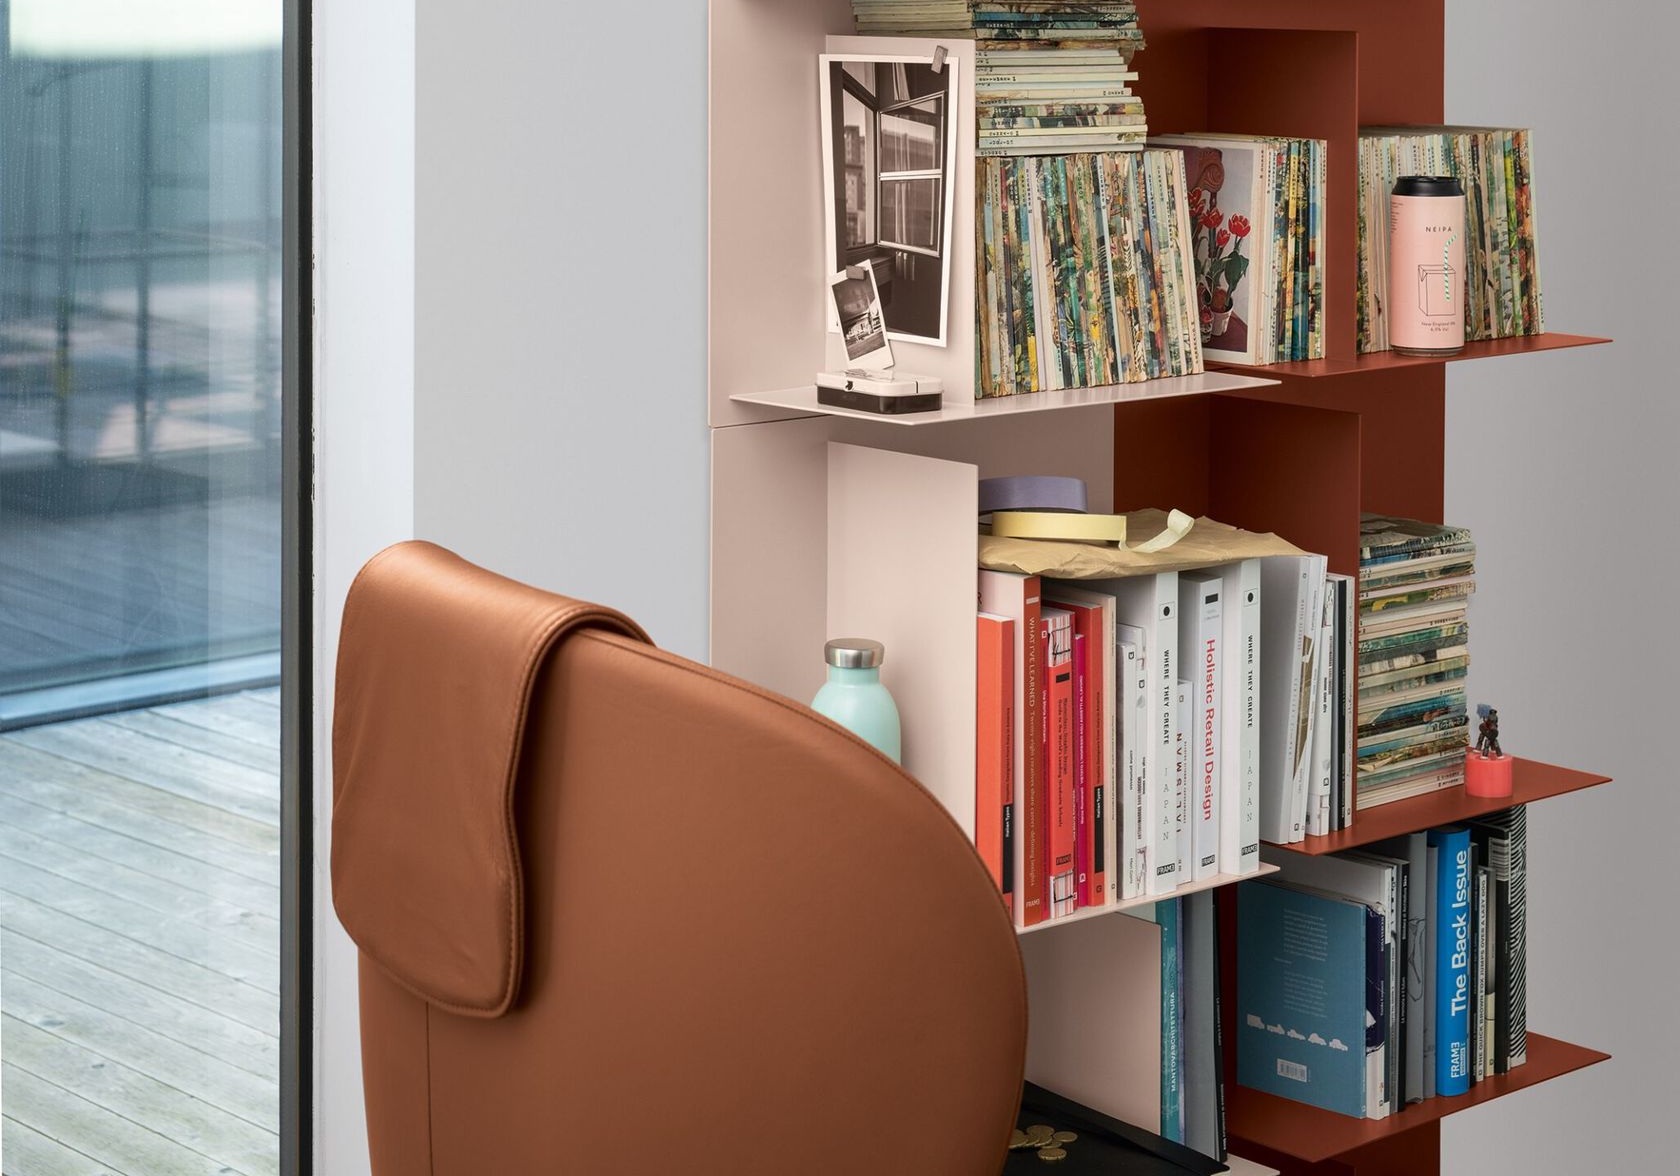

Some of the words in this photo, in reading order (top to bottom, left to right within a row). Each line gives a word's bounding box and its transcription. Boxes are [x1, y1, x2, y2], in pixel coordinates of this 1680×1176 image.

[1206, 640, 1215, 704] Holistic
[1204, 708, 1215, 756] Retail
[1203, 761, 1214, 820] Design
[1452, 850, 1466, 908] Issue
[1452, 913, 1466, 969] Back
[1452, 974, 1466, 1016] The
